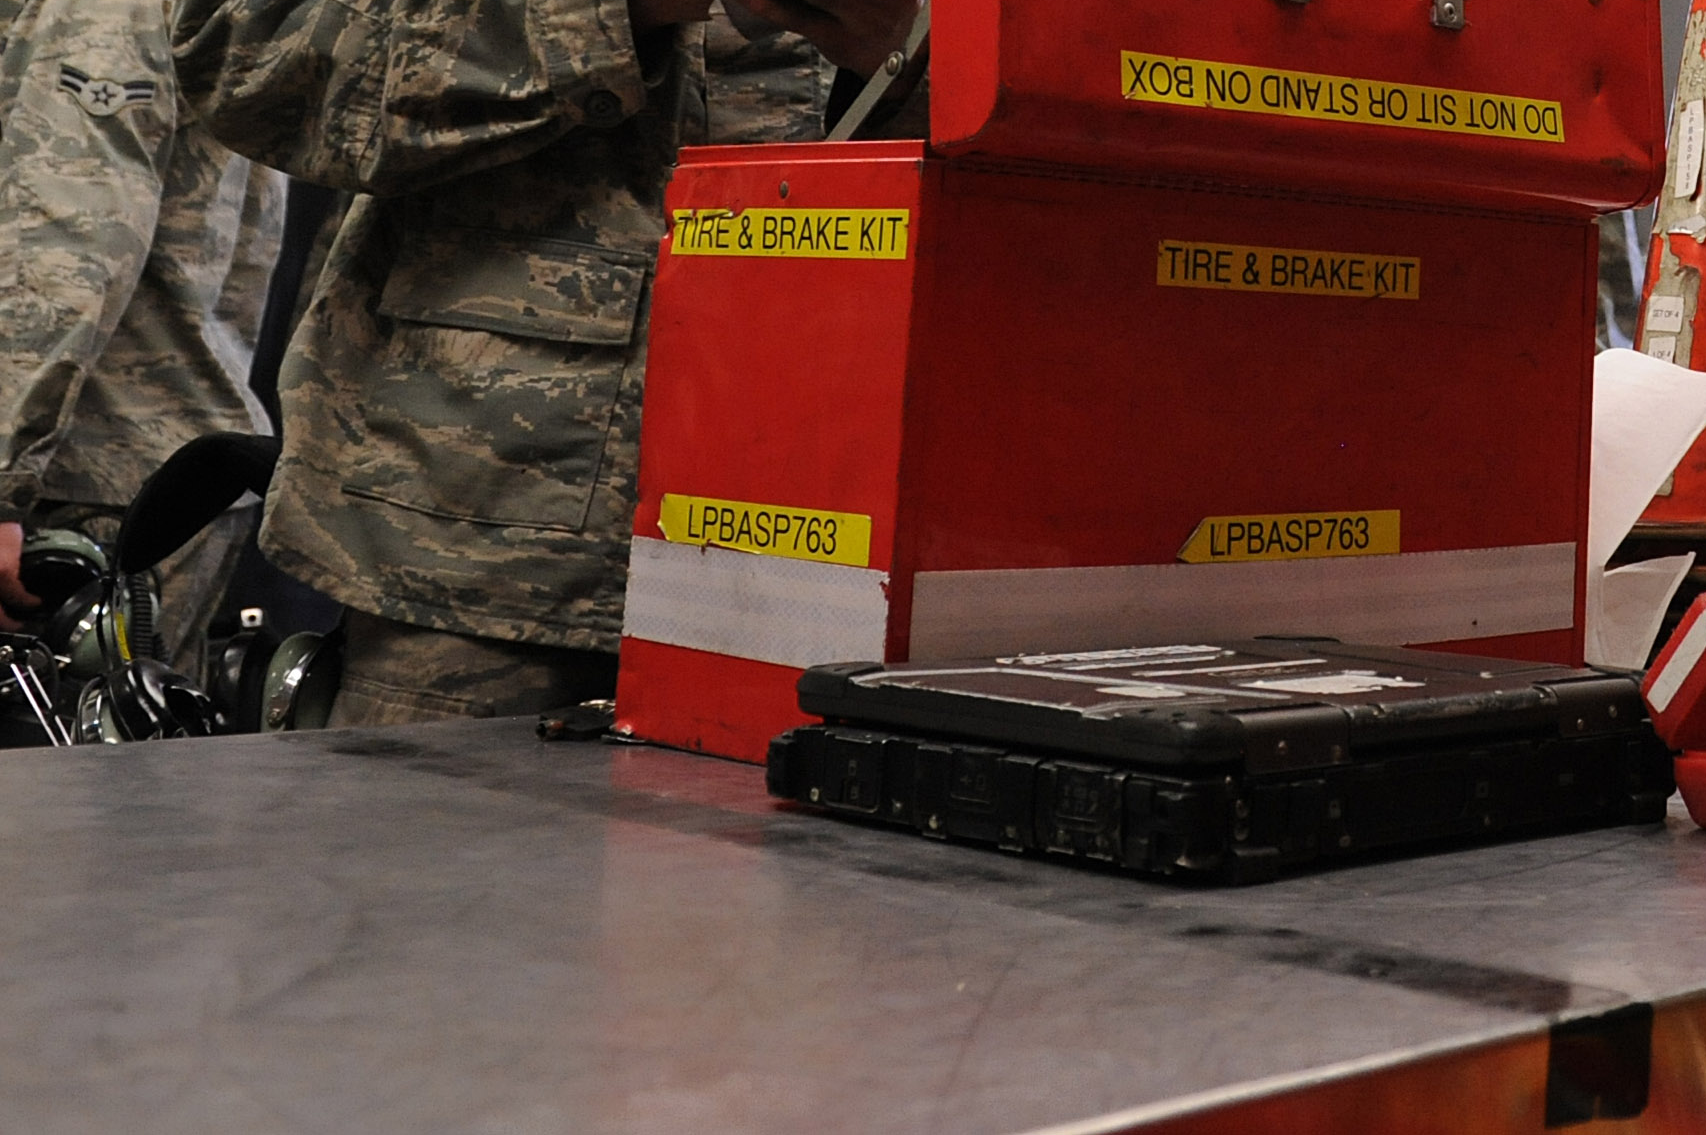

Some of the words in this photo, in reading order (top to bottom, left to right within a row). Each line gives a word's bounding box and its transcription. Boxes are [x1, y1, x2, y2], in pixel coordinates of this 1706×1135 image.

[1128, 58, 1194, 99] BOX
[1206, 68, 1251, 104] ON
[1260, 74, 1359, 117] STAND
[1368, 86, 1408, 121] OR
[1416, 92, 1457, 126] SIT
[1465, 98, 1517, 132] NOT
[1523, 104, 1558, 136] DO
[677, 215, 732, 249] TIRE
[738, 215, 753, 250] &
[762, 216, 851, 251] BRAKE
[859, 217, 903, 251] KIT
[1164, 246, 1234, 283] TIRE
[1241, 252, 1260, 285] &
[1270, 254, 1365, 291] BRAKE
[1374, 261, 1415, 293] KIT
[687, 504, 838, 555] LPBASP763
[1210, 516, 1369, 556] LPBASP763
